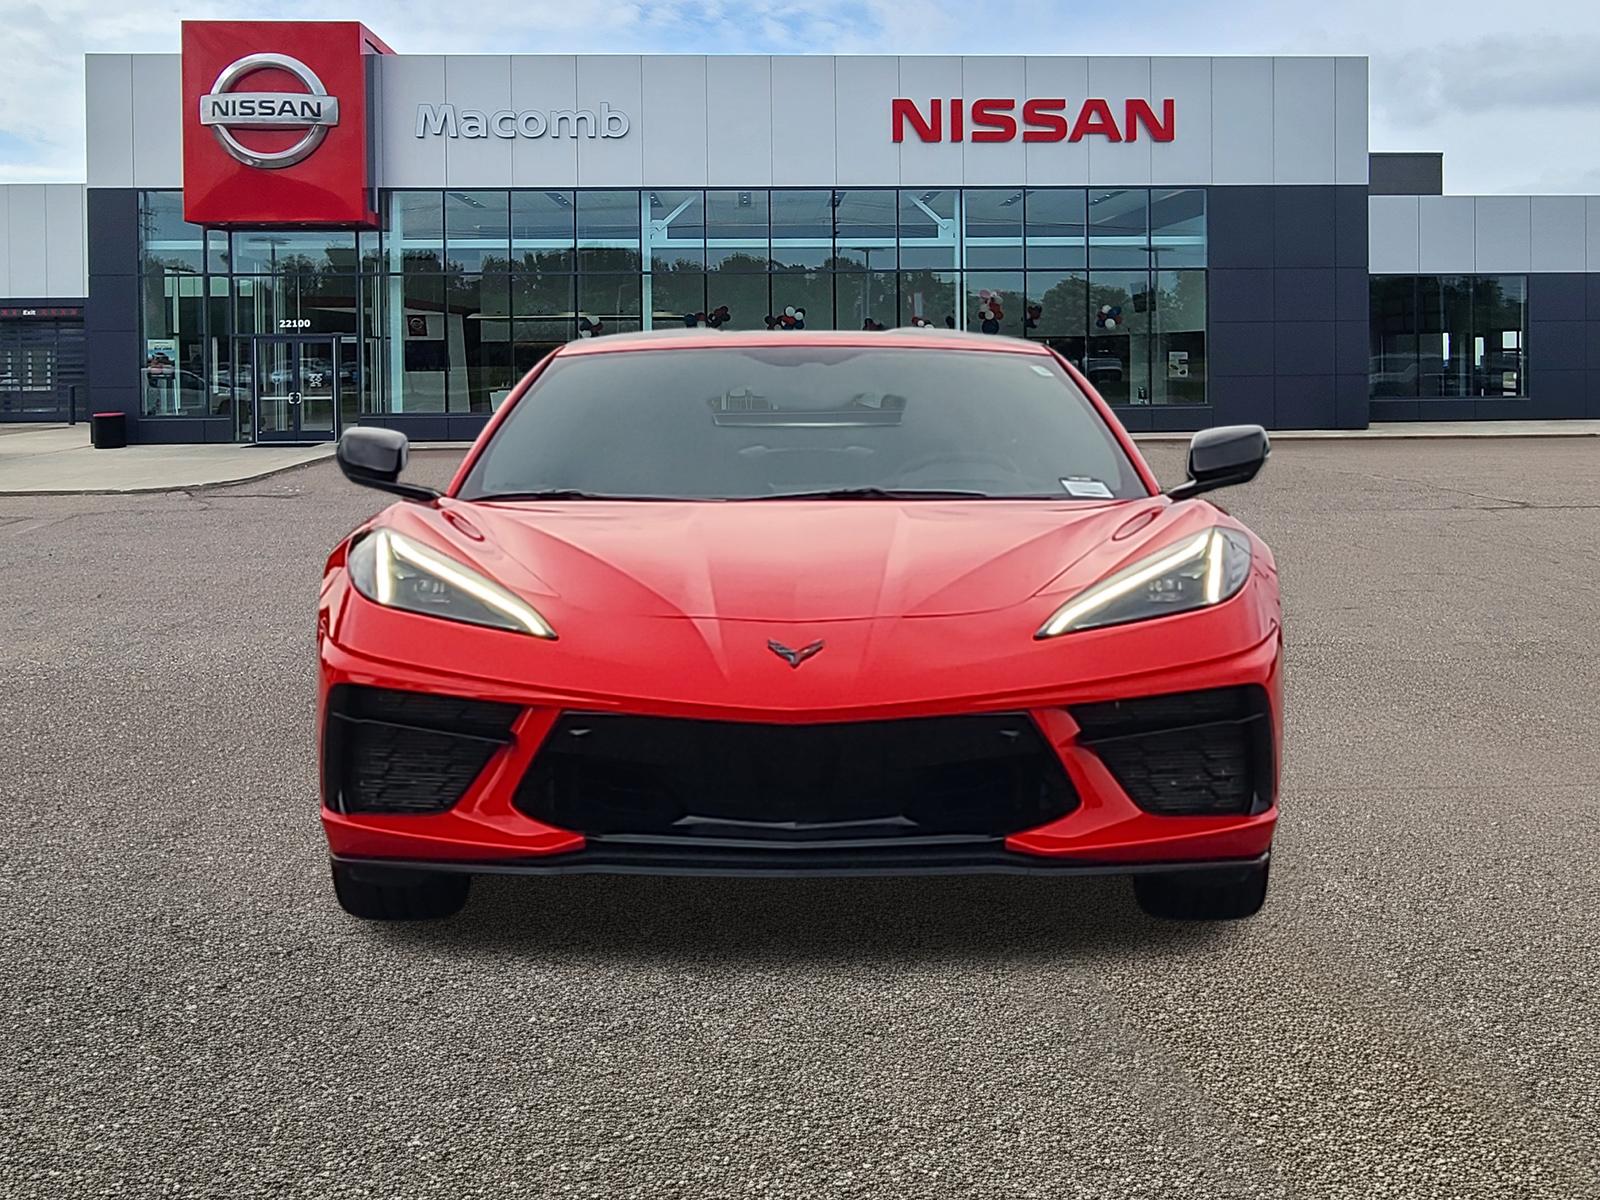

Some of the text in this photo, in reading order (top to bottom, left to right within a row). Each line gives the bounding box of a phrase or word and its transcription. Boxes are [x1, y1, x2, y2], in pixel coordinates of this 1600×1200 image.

[212, 100, 322, 117] NISSAN
[415, 101, 630, 139] Macomb
[892, 98, 1175, 143] NISSAN
[279, 319, 311, 328] 22100
